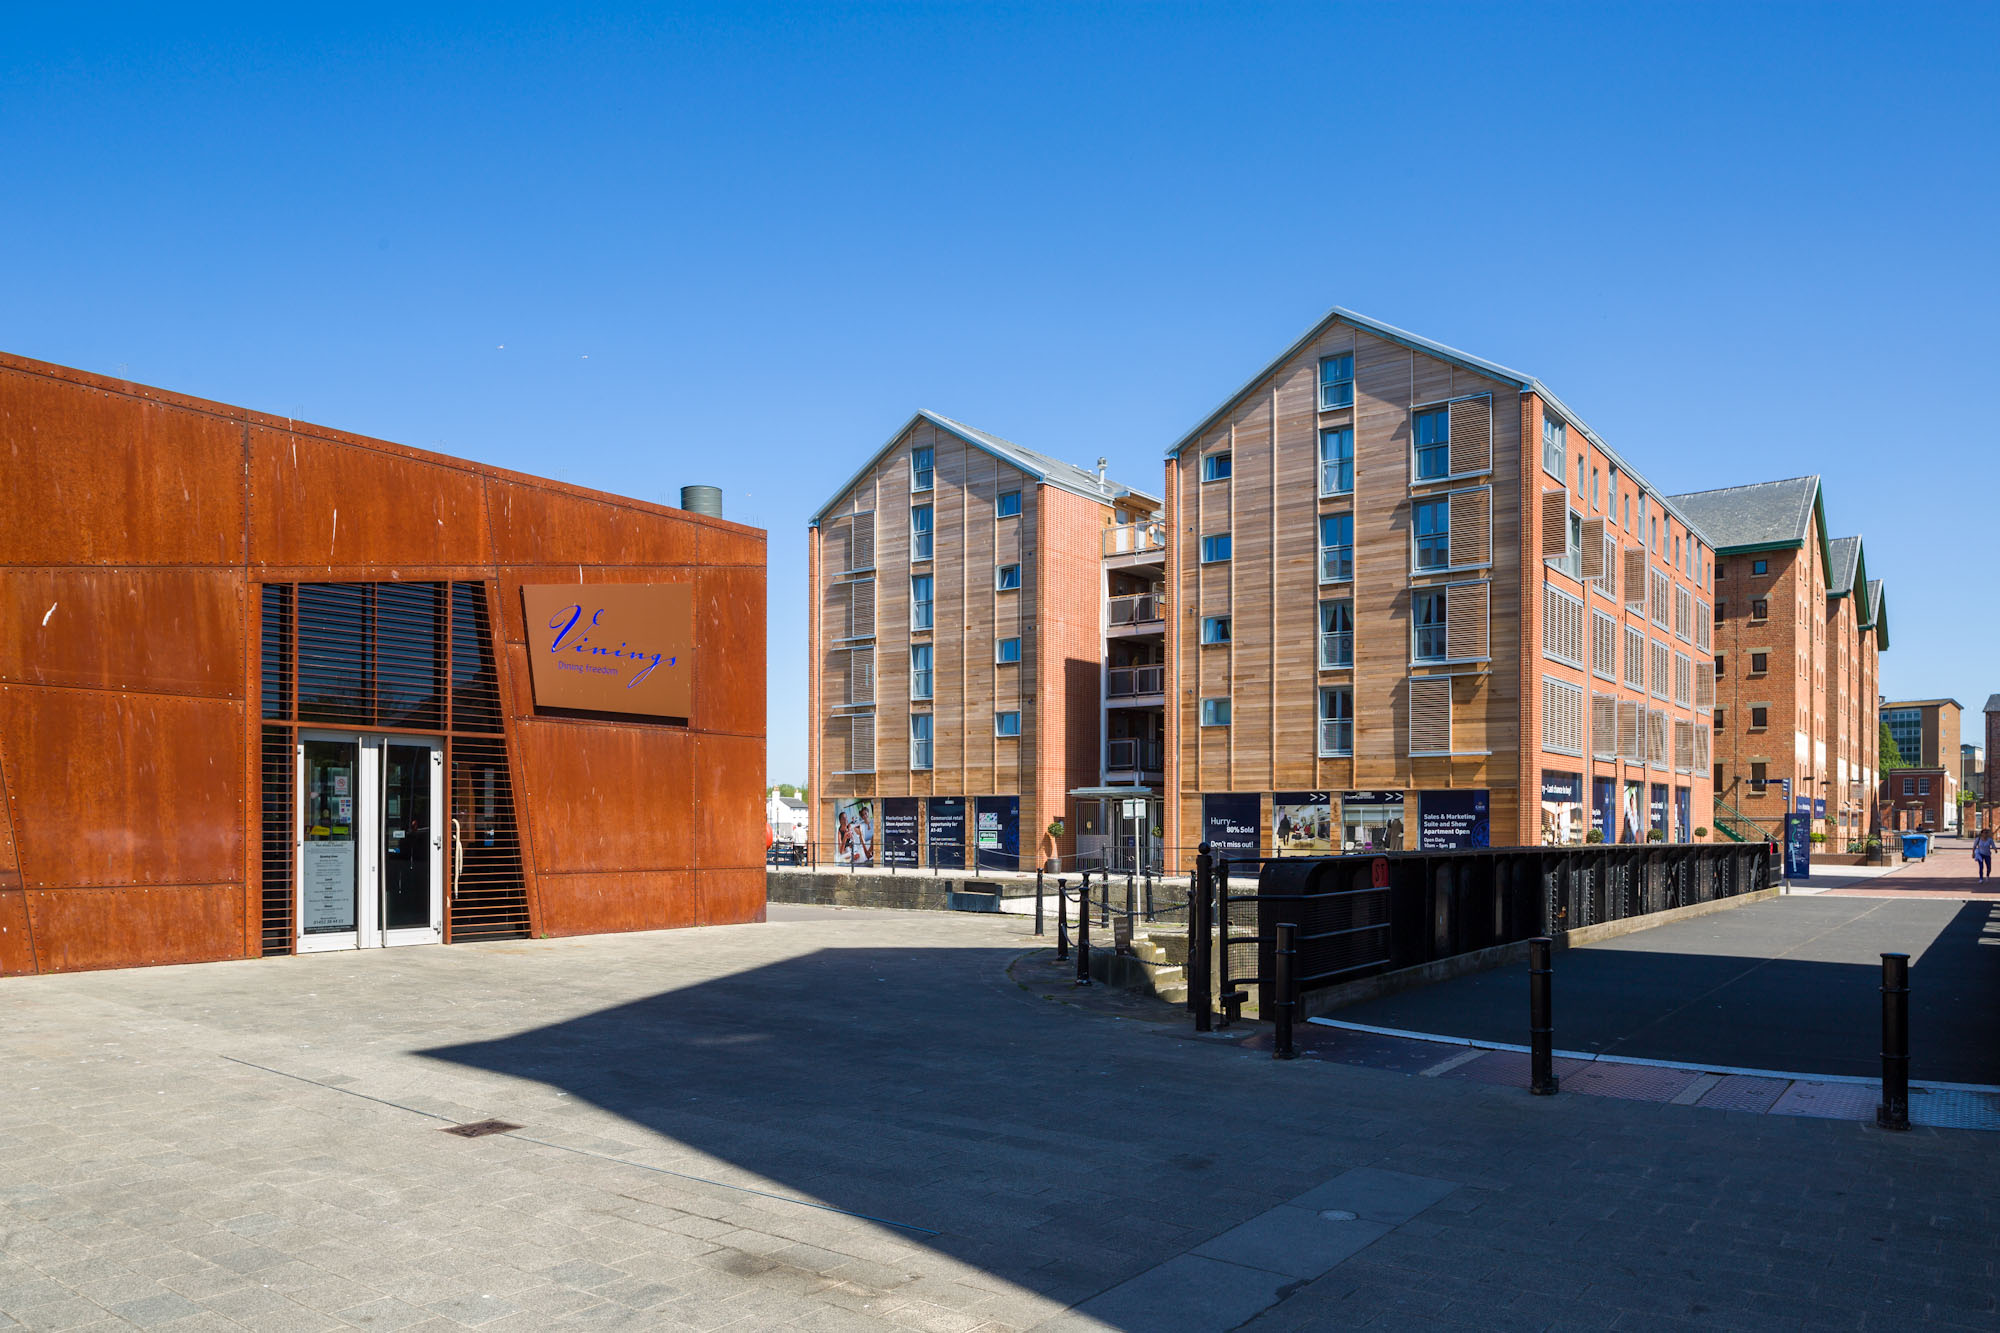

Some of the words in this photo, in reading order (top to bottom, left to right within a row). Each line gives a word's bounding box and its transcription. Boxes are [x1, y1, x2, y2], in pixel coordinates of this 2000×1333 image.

[549, 604, 677, 688] Vinings
[558, 660, 584, 674] Dining
[585, 663, 619, 676] freedom
[1210, 816, 1231, 827] Hurry
[1455, 828, 1470, 836] Open
[1210, 840, 1226, 848] Don't
[1227, 840, 1241, 848] miss
